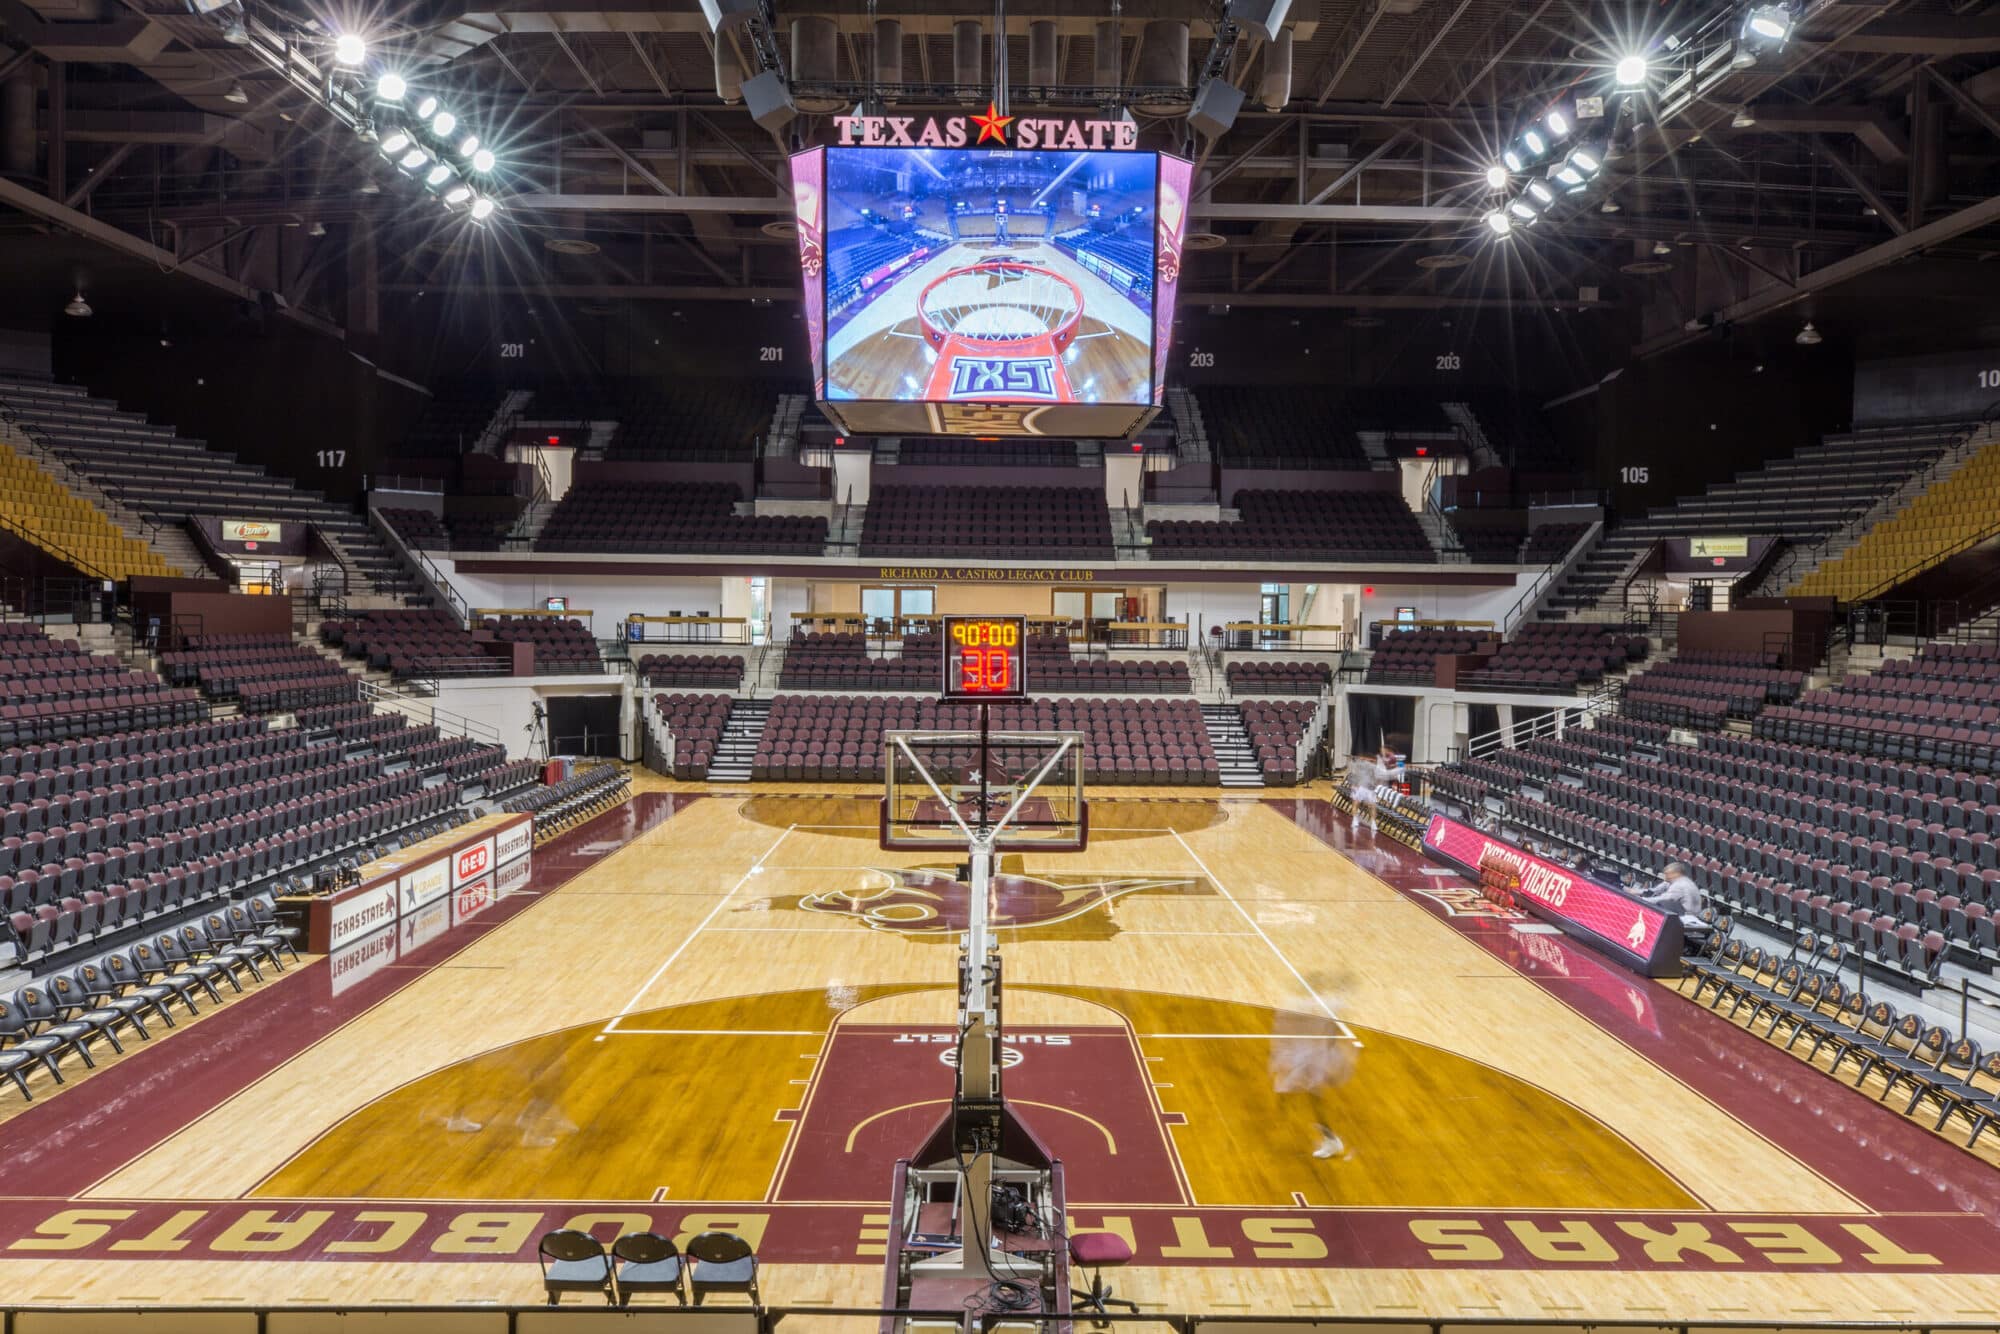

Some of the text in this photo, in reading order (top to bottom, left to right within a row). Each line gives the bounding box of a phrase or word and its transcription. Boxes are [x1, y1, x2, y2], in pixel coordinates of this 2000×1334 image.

[833, 116, 1137, 150] TEXAS STATE
[500, 343, 524, 358] 201
[759, 347, 783, 361] 201
[1189, 353, 1215, 367] 203
[1436, 356, 1460, 370] 203
[953, 358, 1053, 394] TXST
[316, 450, 346, 468] 117
[1620, 466, 1649, 484] 105
[880, 567, 1094, 581] RICHARD A. CASTRO LEGACY CLUB
[953, 624, 1017, 647] 90:00
[962, 649, 1008, 688] 30
[497, 841, 510, 858] EXAS
[460, 849, 487, 875] H-E-B
[1476, 841, 1573, 908] TM/TICKETS
[333, 902, 385, 940] TEXAS STATE
[855, 1213, 1329, 1260] STAE
[1408, 1218, 1944, 1265] TEXAS
